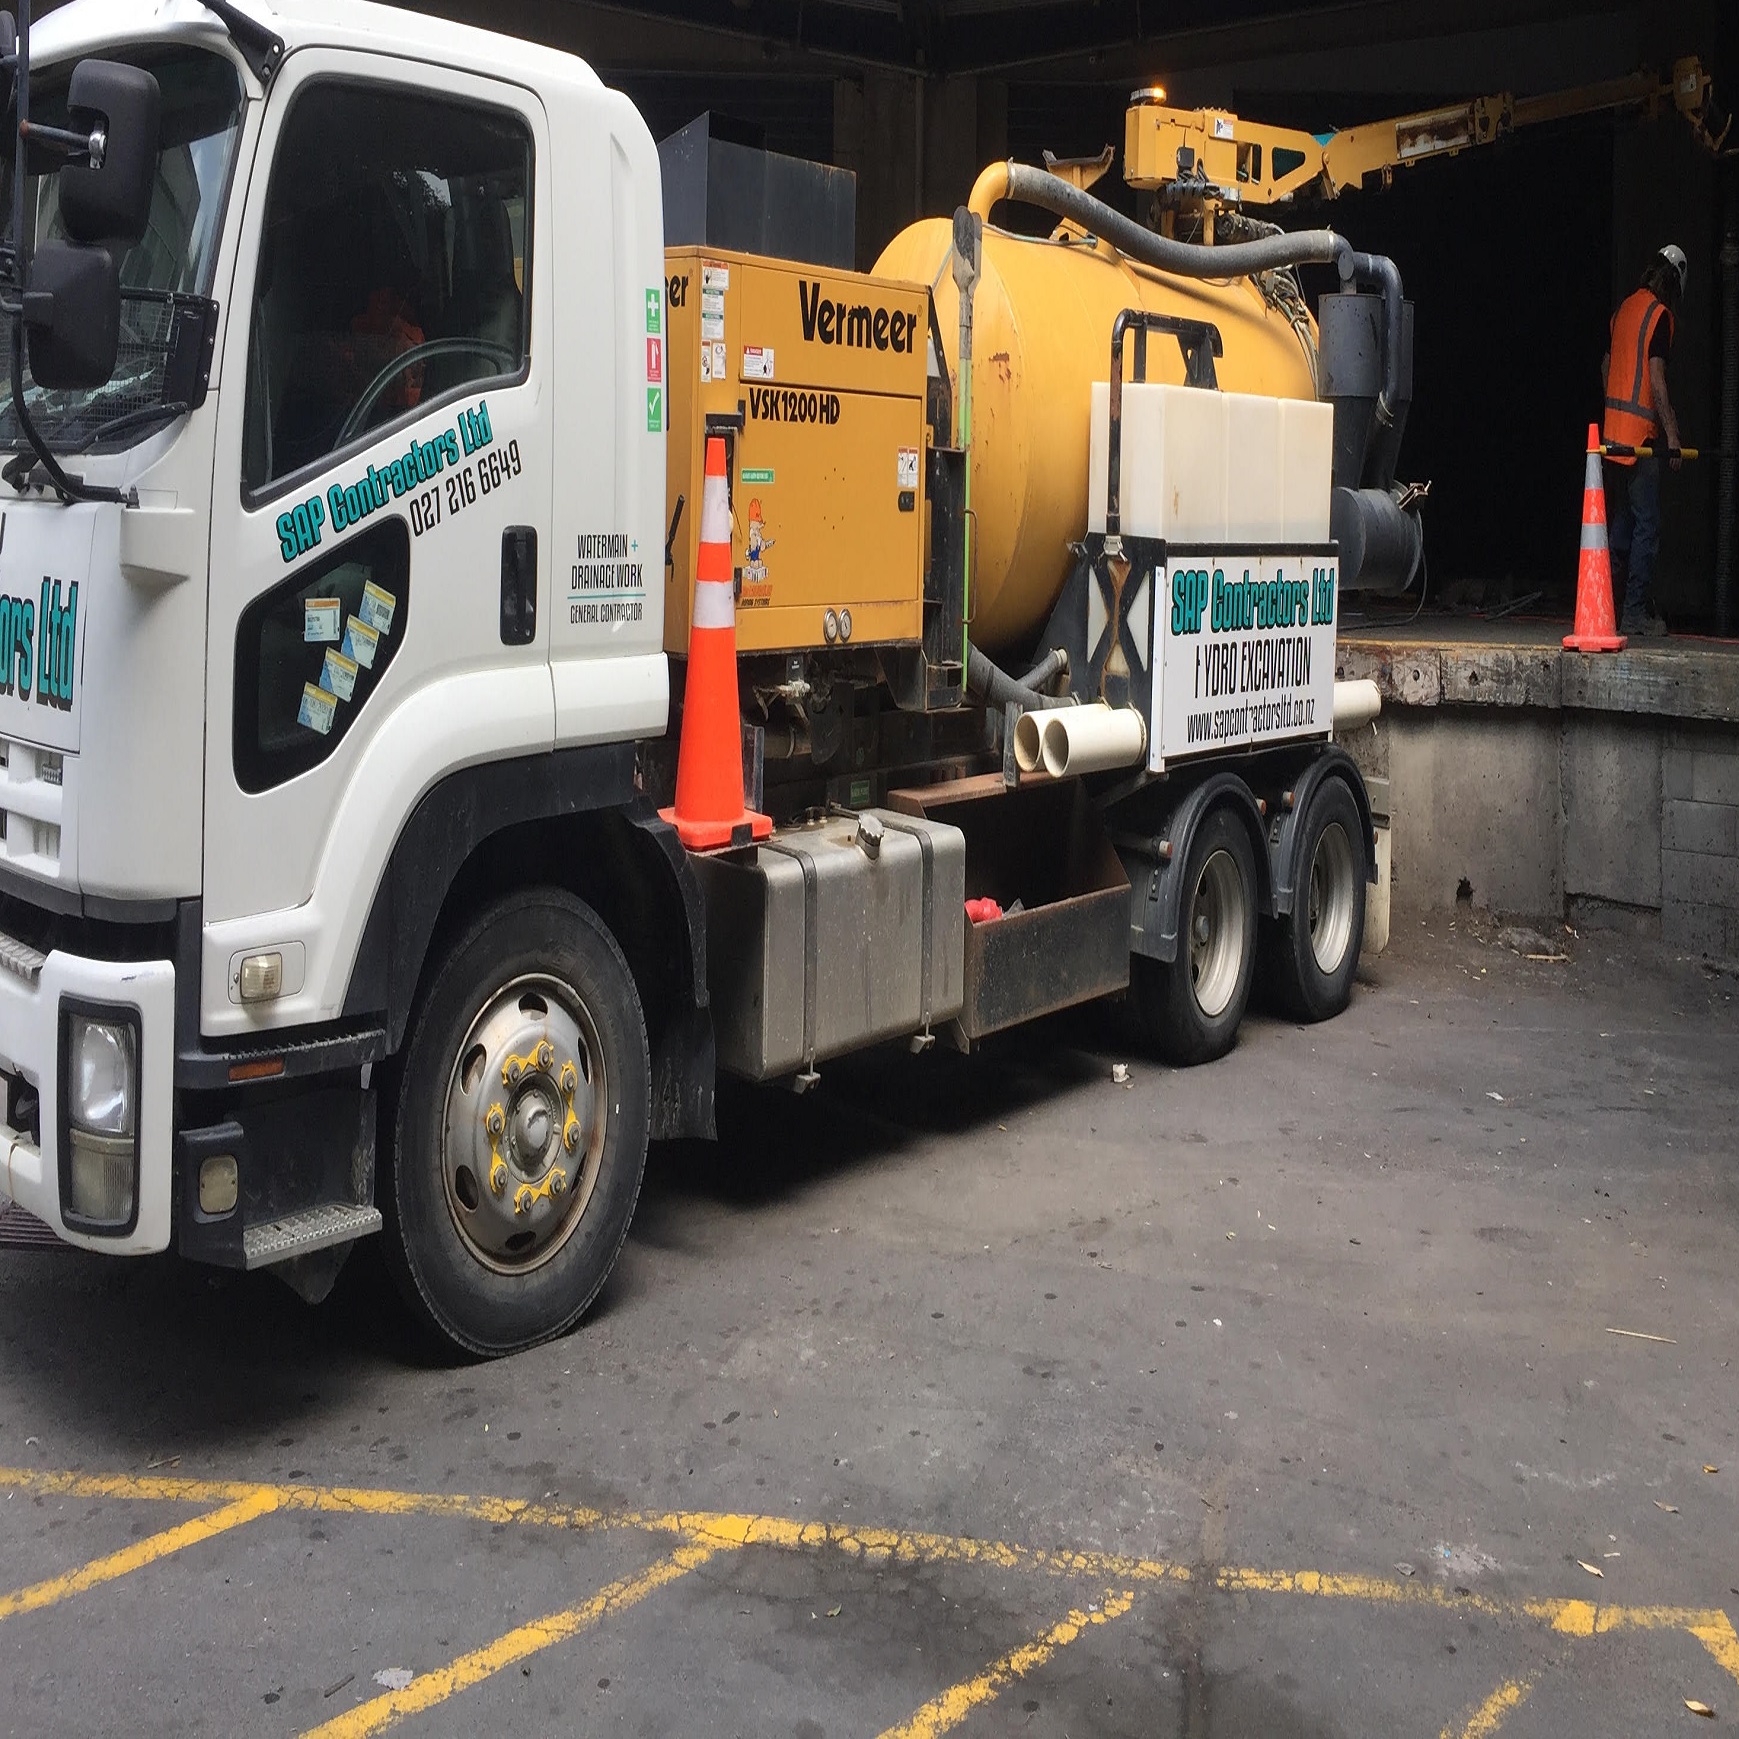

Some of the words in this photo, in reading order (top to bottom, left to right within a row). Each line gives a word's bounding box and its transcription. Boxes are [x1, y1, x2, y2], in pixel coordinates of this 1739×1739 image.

[665, 275, 689, 307] er
[799, 280, 917, 353] Vermeer
[276, 495, 325, 563] SAP
[327, 428, 459, 533] Contractors
[457, 400, 494, 457] Ltd
[409, 485, 441, 537] 027
[446, 466, 476, 515] 216
[477, 439, 522, 495] 6649
[571, 564, 615, 589] DRAINAGE
[616, 563, 643, 587] WORK
[577, 534, 628, 559] WATERMAIN
[570, 604, 599, 624] GENERAL
[600, 602, 643, 622] CONTRACTOR
[1171, 569, 1209, 636] SAP
[1211, 568, 1310, 633] Contractors
[1311, 567, 1335, 626] Ltd
[36, 576, 79, 712] Ltd
[1240, 636, 1312, 692] EXCAVATION
